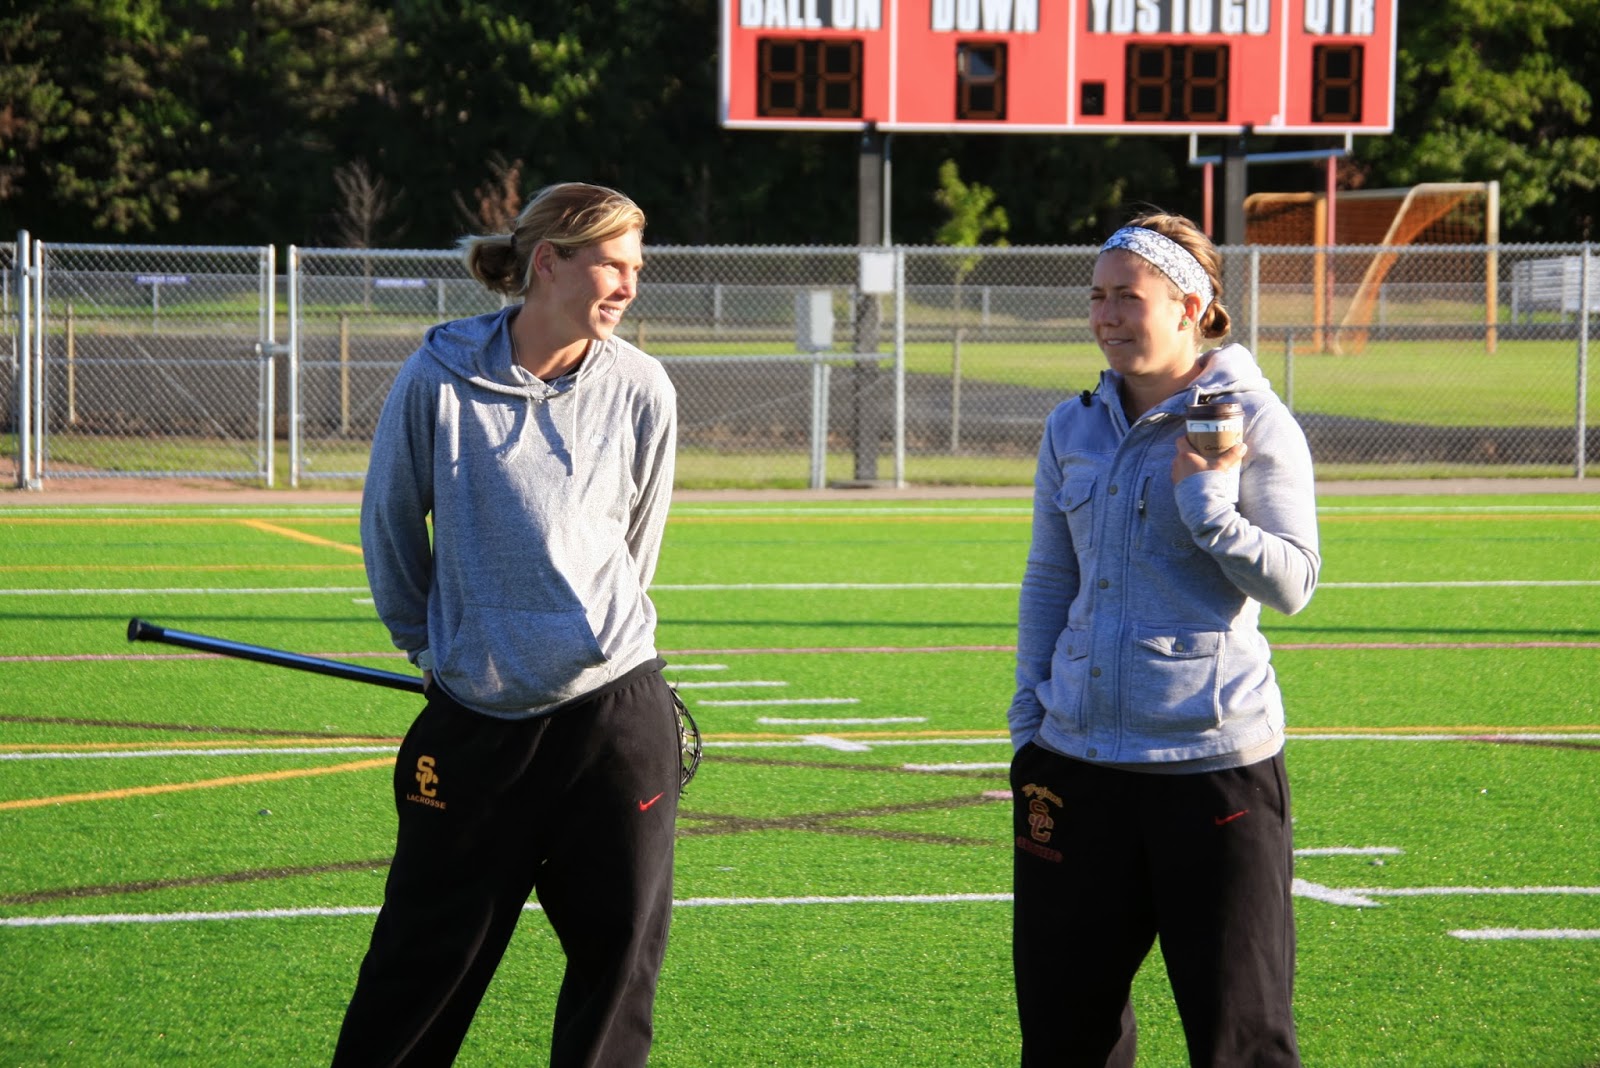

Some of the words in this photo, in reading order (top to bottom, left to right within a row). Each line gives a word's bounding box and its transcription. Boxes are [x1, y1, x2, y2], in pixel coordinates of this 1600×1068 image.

[740, 0, 822, 29] BALL
[832, 0, 881, 31] ON
[931, 0, 1038, 33] DOWN
[1091, 0, 1160, 34] YDS
[1170, 0, 1212, 35] TO
[1220, 0, 1269, 35] GO
[1304, 0, 1374, 35] QTR
[406, 793, 446, 809] LACROSSE
